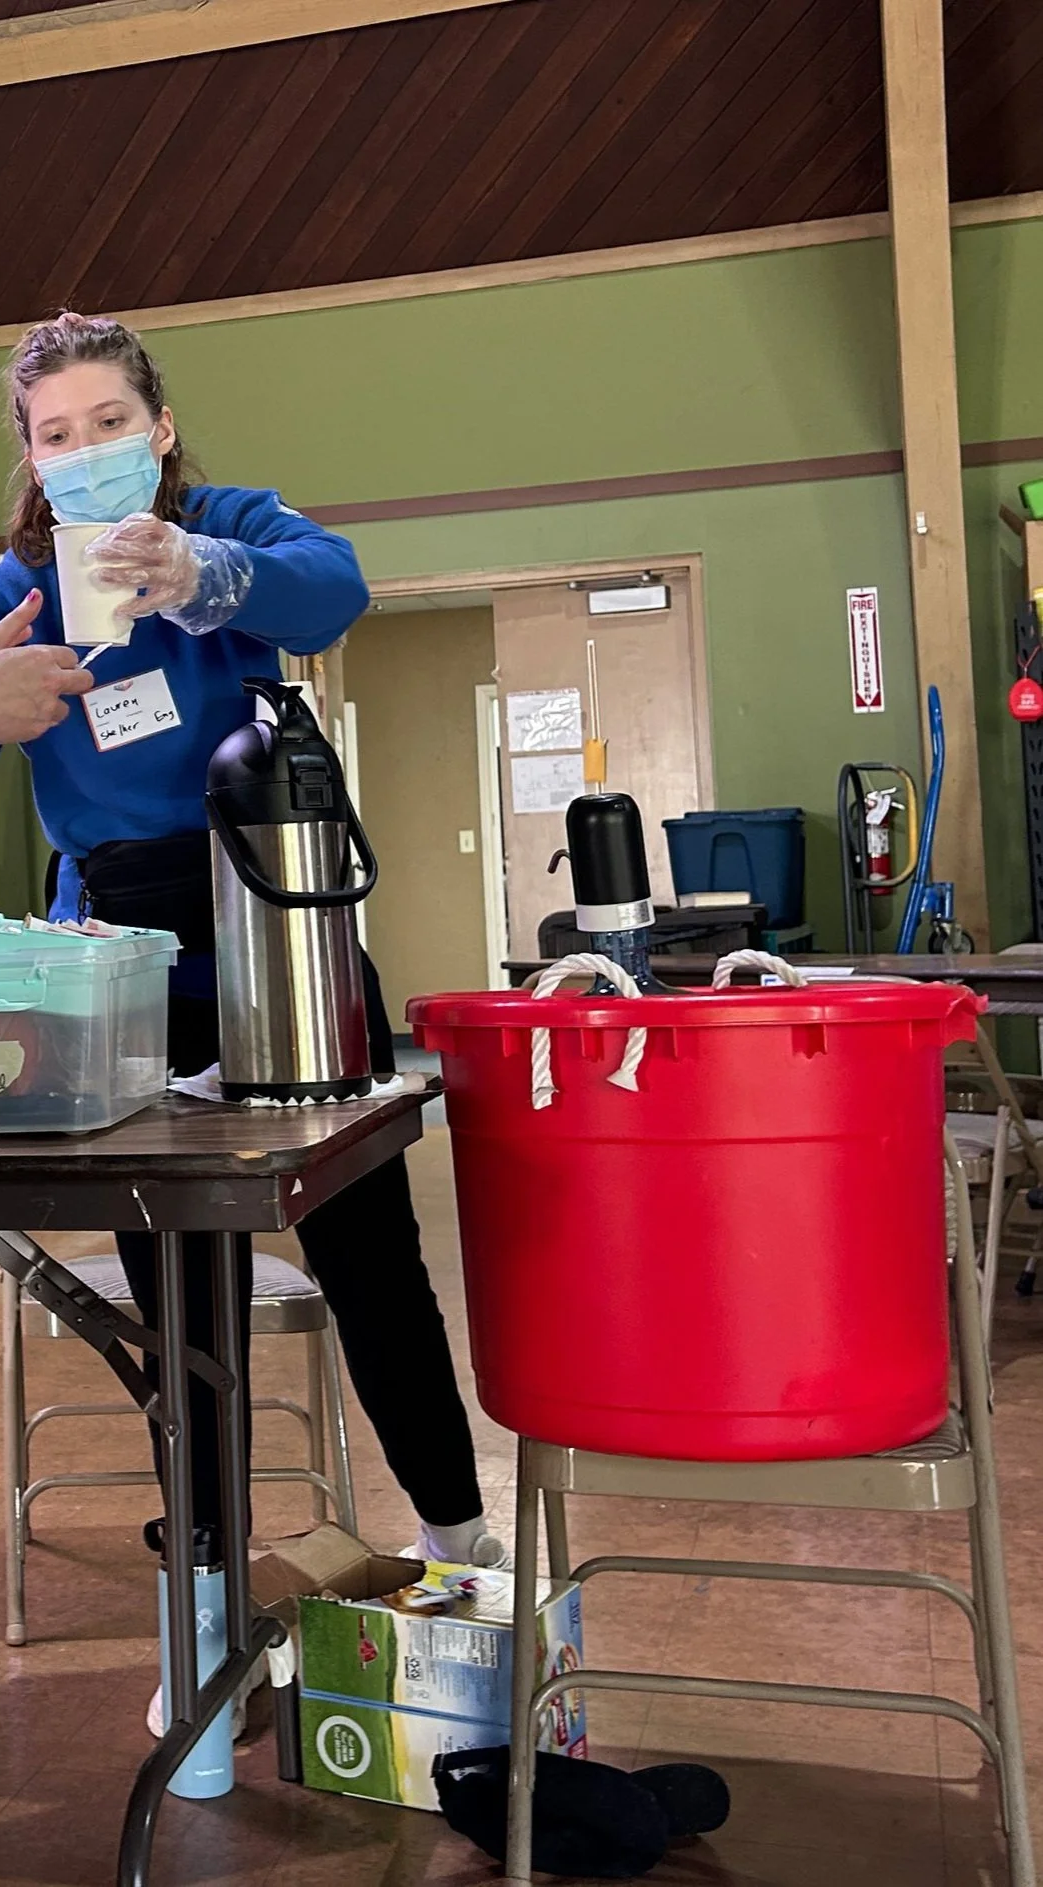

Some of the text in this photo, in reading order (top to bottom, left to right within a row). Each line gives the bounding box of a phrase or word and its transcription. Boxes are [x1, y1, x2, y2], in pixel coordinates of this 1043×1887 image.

[852, 599, 874, 611] FIRE
[859, 612, 872, 700] EXTINGUISHER
[95, 697, 140, 719] Lauren
